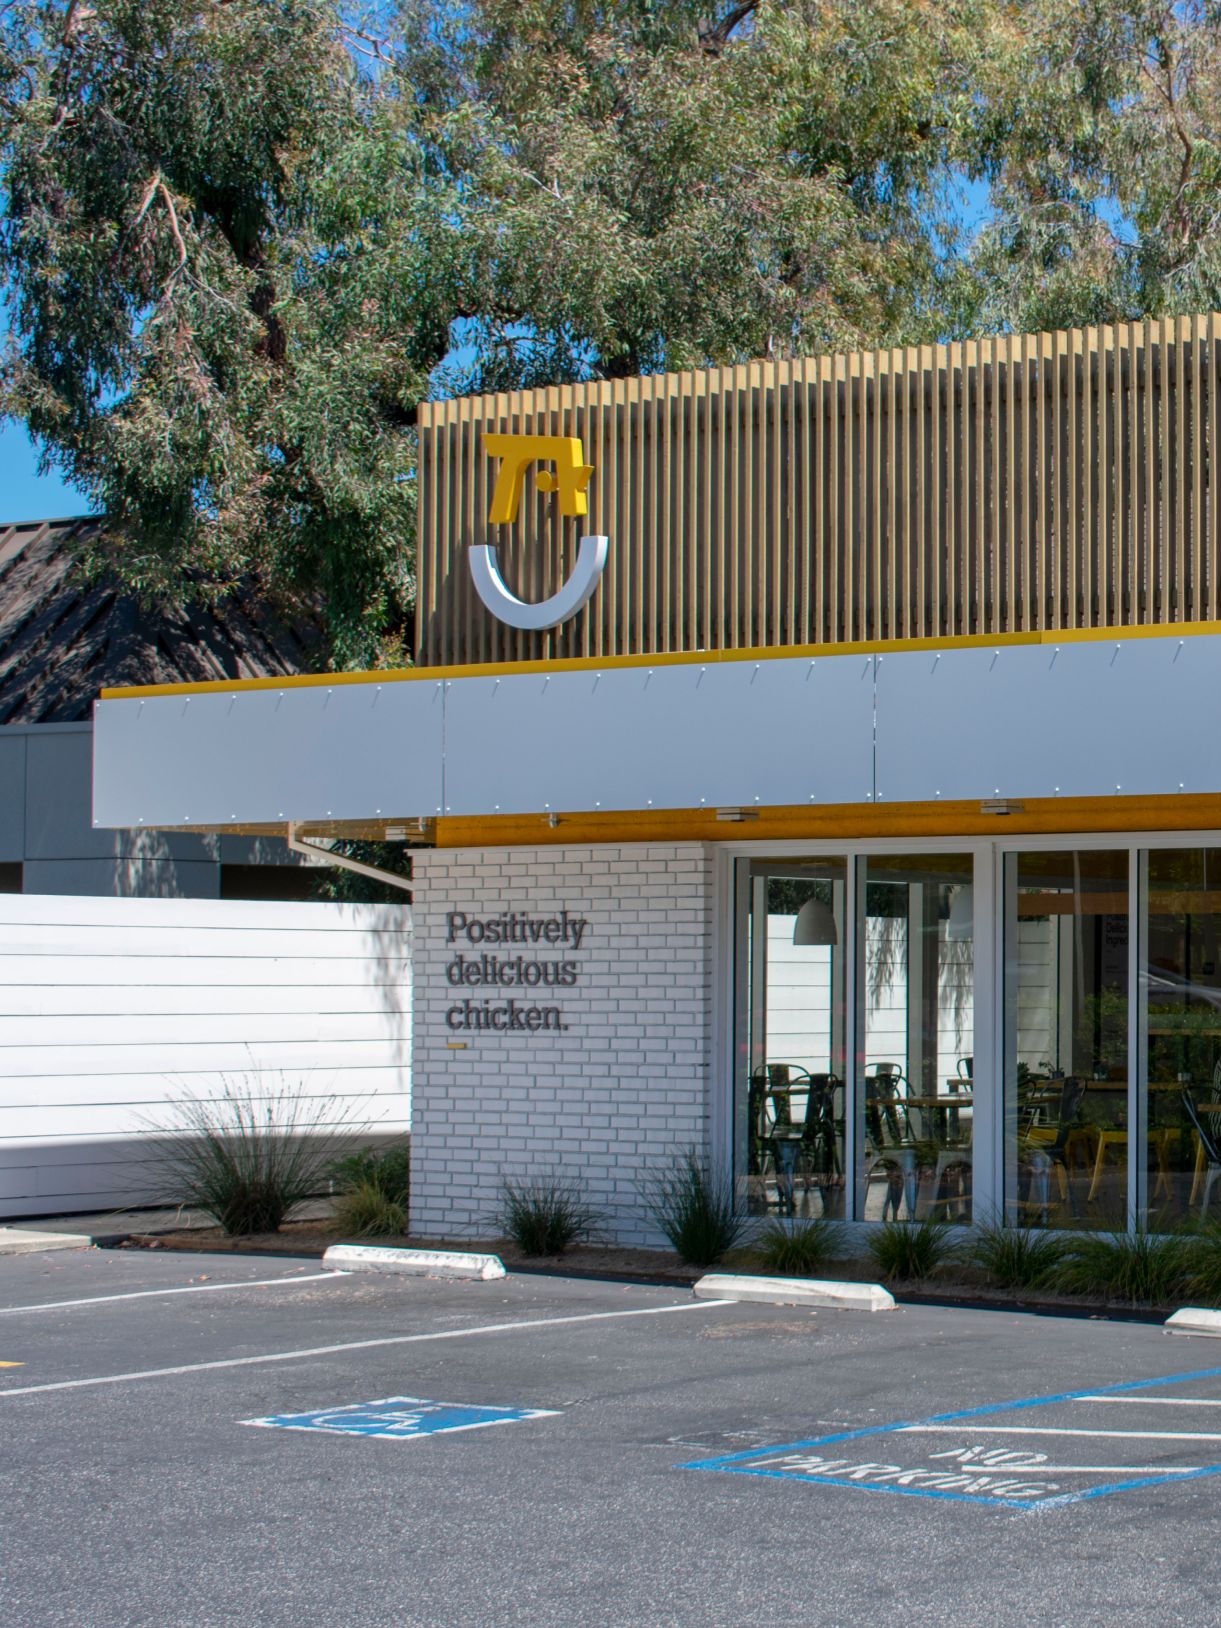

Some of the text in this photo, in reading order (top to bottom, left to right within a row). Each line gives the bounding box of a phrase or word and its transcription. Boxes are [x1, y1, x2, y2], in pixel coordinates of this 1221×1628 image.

[446, 911, 587, 950] Positively
[446, 954, 578, 986] delicious
[445, 1000, 569, 1031] chicken.
[928, 1446, 1048, 1465] NO
[748, 1455, 1060, 1497] PARKING
